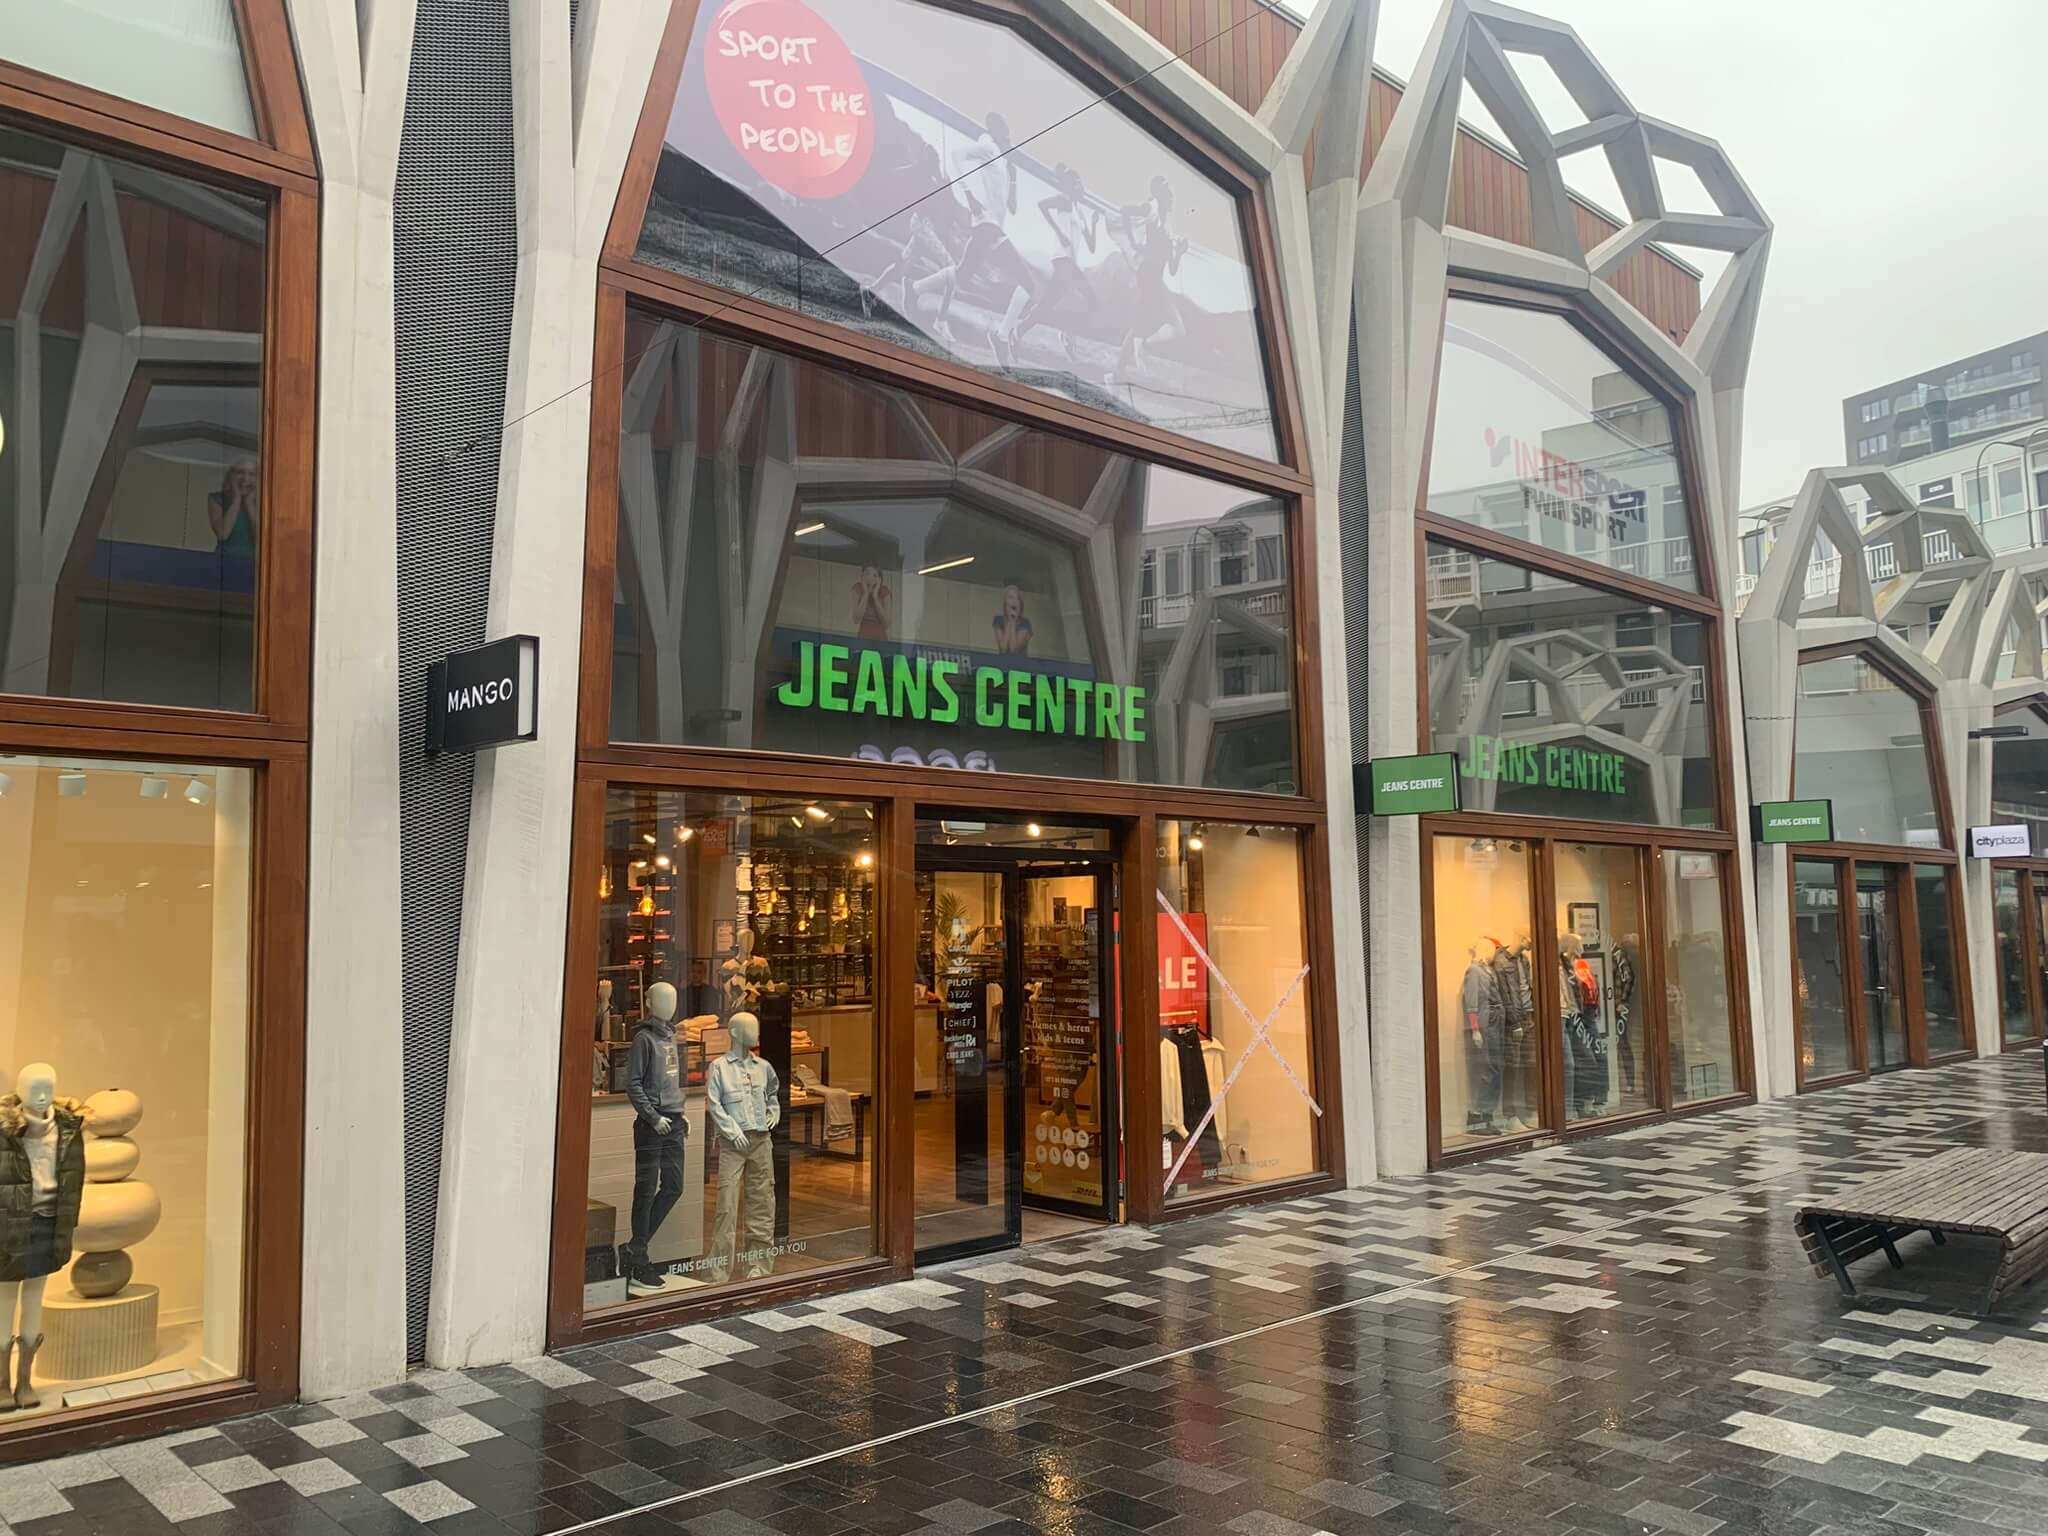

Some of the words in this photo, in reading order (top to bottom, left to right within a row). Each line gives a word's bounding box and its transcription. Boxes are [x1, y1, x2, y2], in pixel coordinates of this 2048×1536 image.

[719, 30, 817, 66] SPORT
[748, 79, 796, 109] TO
[806, 85, 866, 116] THE
[740, 122, 852, 158] PEOPLE
[448, 678, 513, 713] MANGO
[777, 640, 959, 723] JEANS
[975, 666, 1146, 742] CENTRE
[1460, 735, 1539, 785] JEANS
[1544, 746, 1626, 794] CENTRE
[1381, 780, 1409, 792] JEANS
[1410, 778, 1445, 791] CENTRE
[1768, 818, 1792, 827] JEANS
[1792, 816, 1822, 826] CENTRE
[947, 978, 973, 987] PILOT
[1158, 956, 1197, 989] LE
[668, 1262, 694, 1275] JEANS
[696, 1255, 729, 1271] CENTRE
[736, 1249, 763, 1263] THERE
[766, 1244, 785, 1257] FOR
[787, 1241, 807, 1252] YOU
